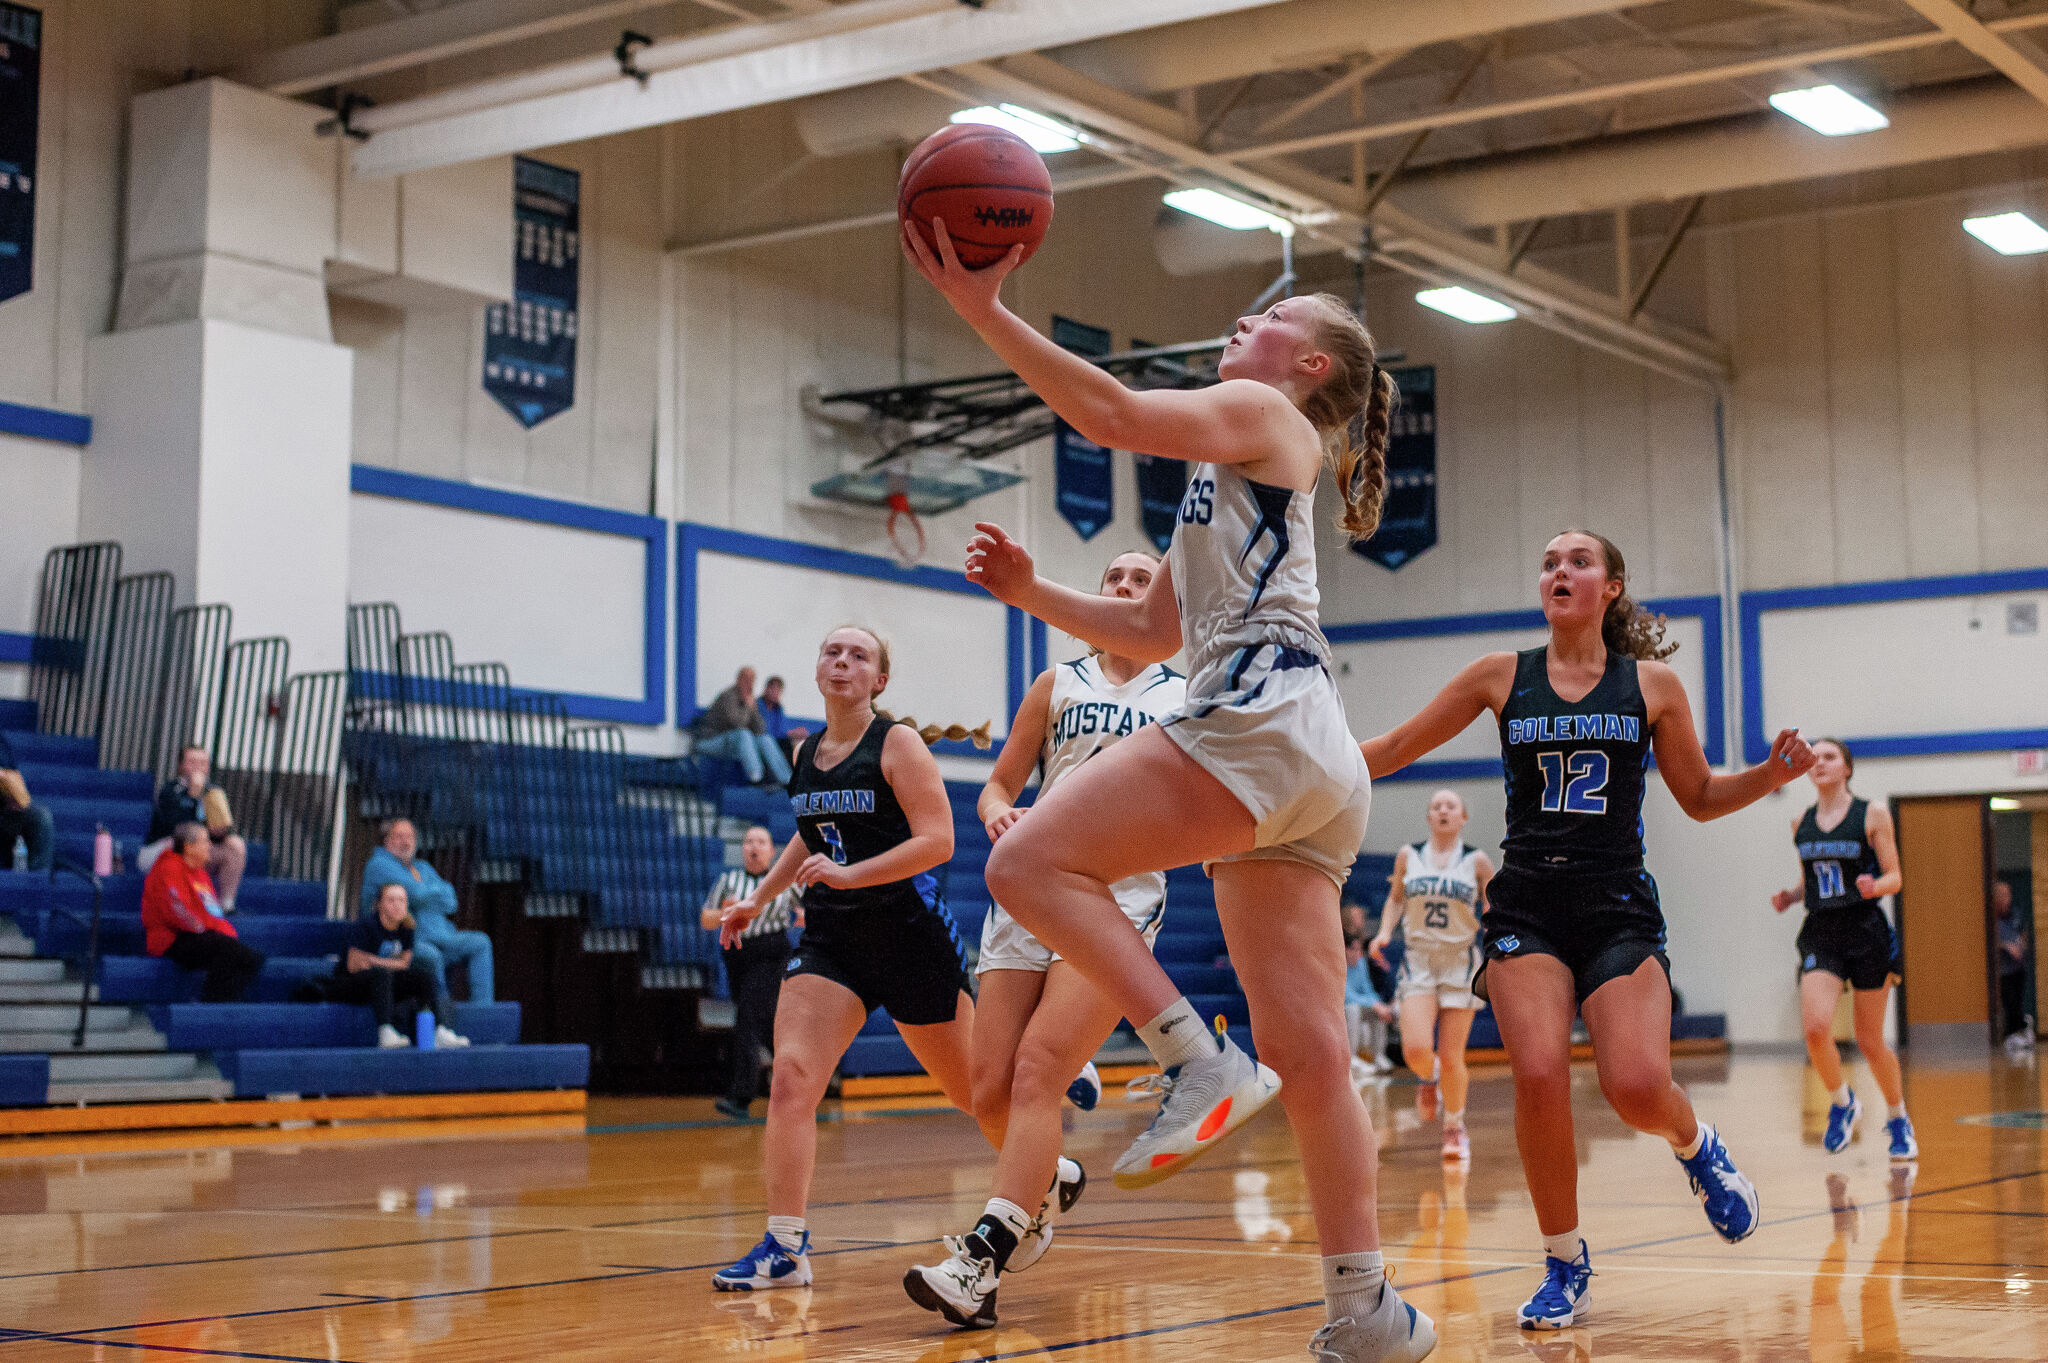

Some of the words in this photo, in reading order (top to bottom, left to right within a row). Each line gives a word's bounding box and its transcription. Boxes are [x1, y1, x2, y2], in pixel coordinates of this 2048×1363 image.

[1508, 714, 1639, 745] COLEMAN
[1537, 750, 1610, 815] 12
[1812, 860, 1846, 899] 11
[1424, 901, 1449, 929] 25
